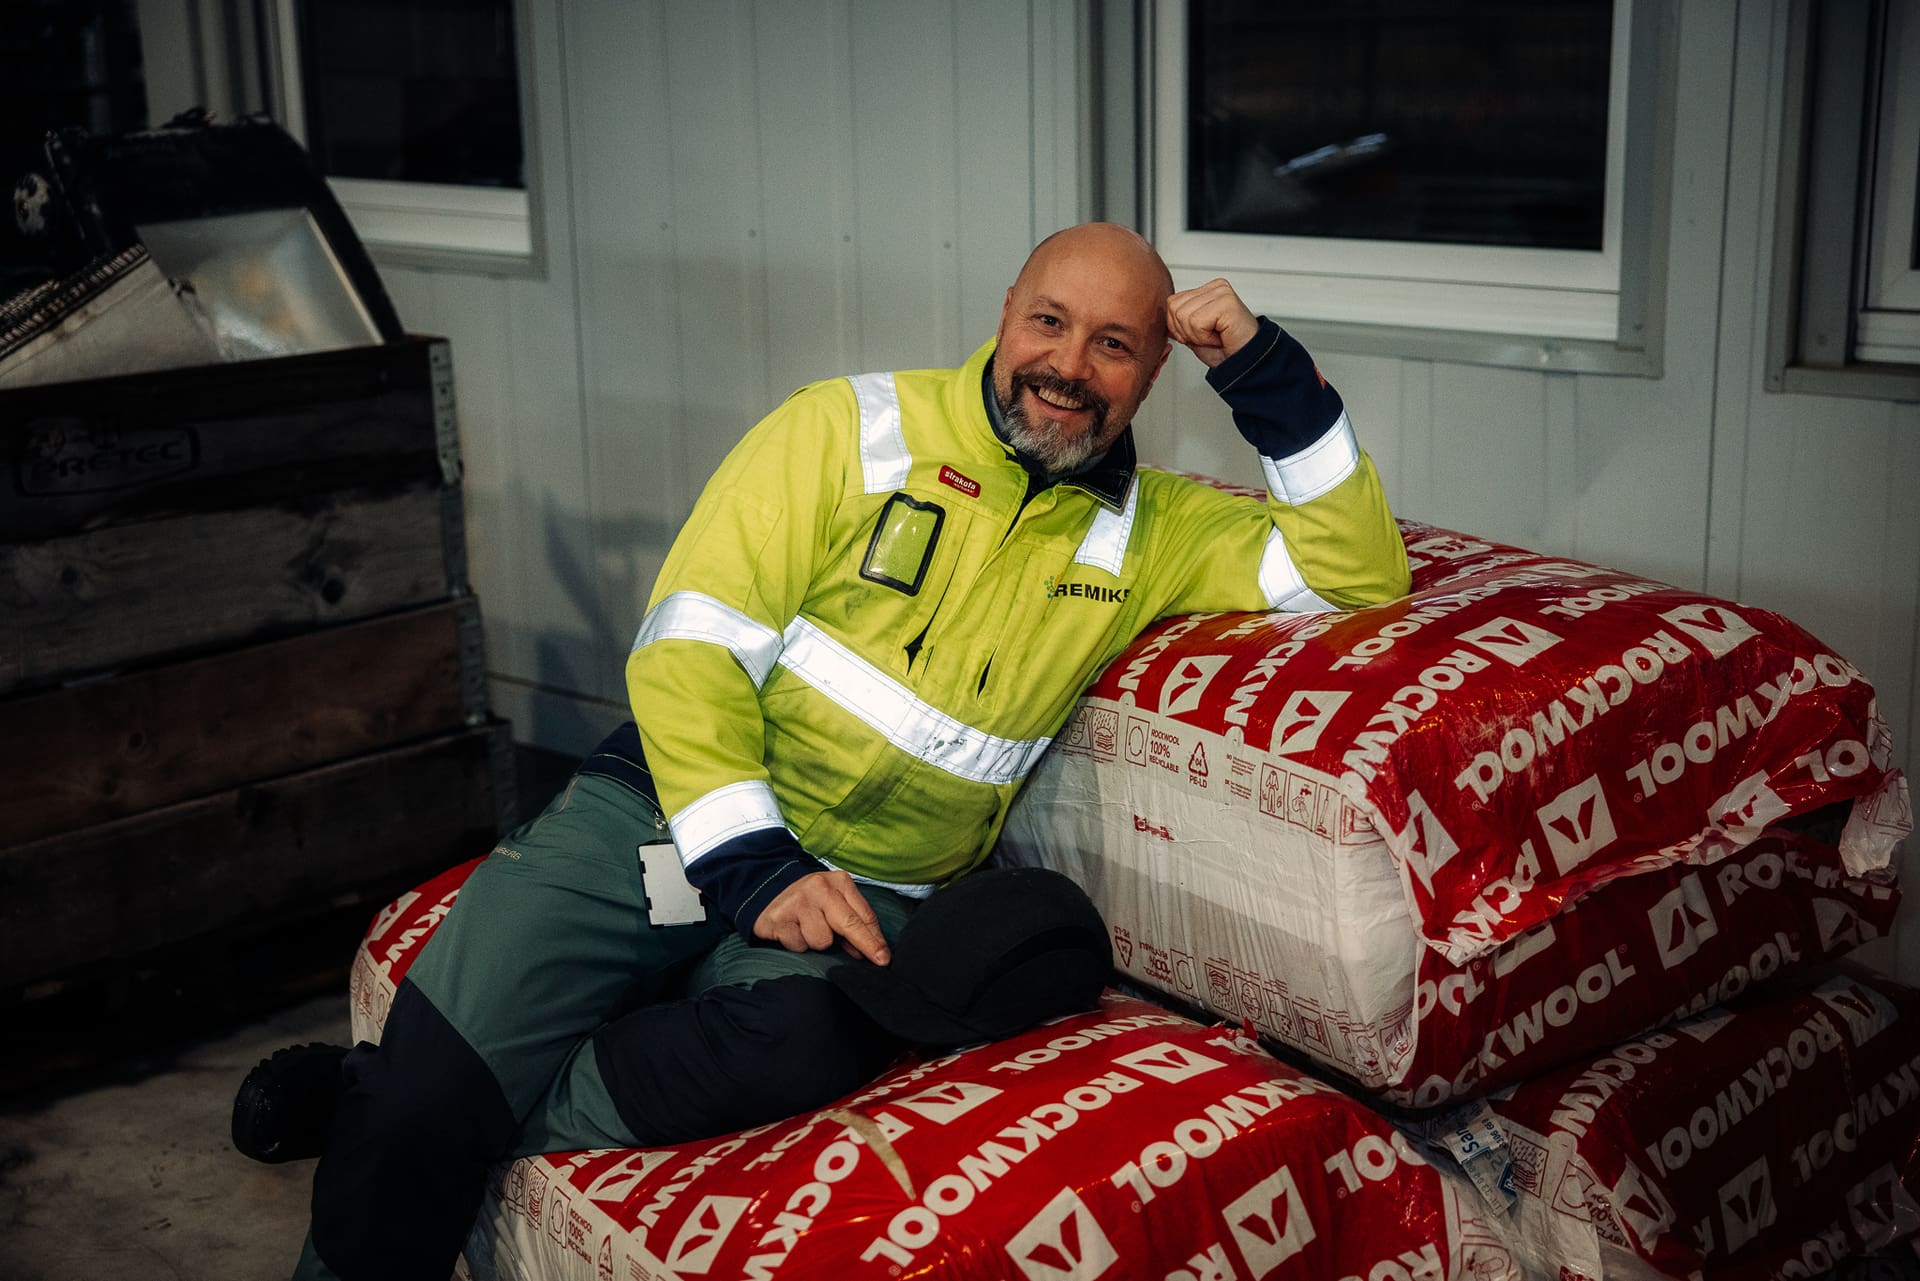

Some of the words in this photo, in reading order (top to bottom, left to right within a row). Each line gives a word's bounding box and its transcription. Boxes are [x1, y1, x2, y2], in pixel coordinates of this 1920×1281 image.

[1151, 729, 1180, 746] ROCKWOOL
[1150, 741, 1171, 759] 100%
[1149, 755, 1180, 774] RECYCLABLE
[1189, 776, 1208, 789] PE-LD
[860, 1071, 1144, 1268] ROCKWOOL
